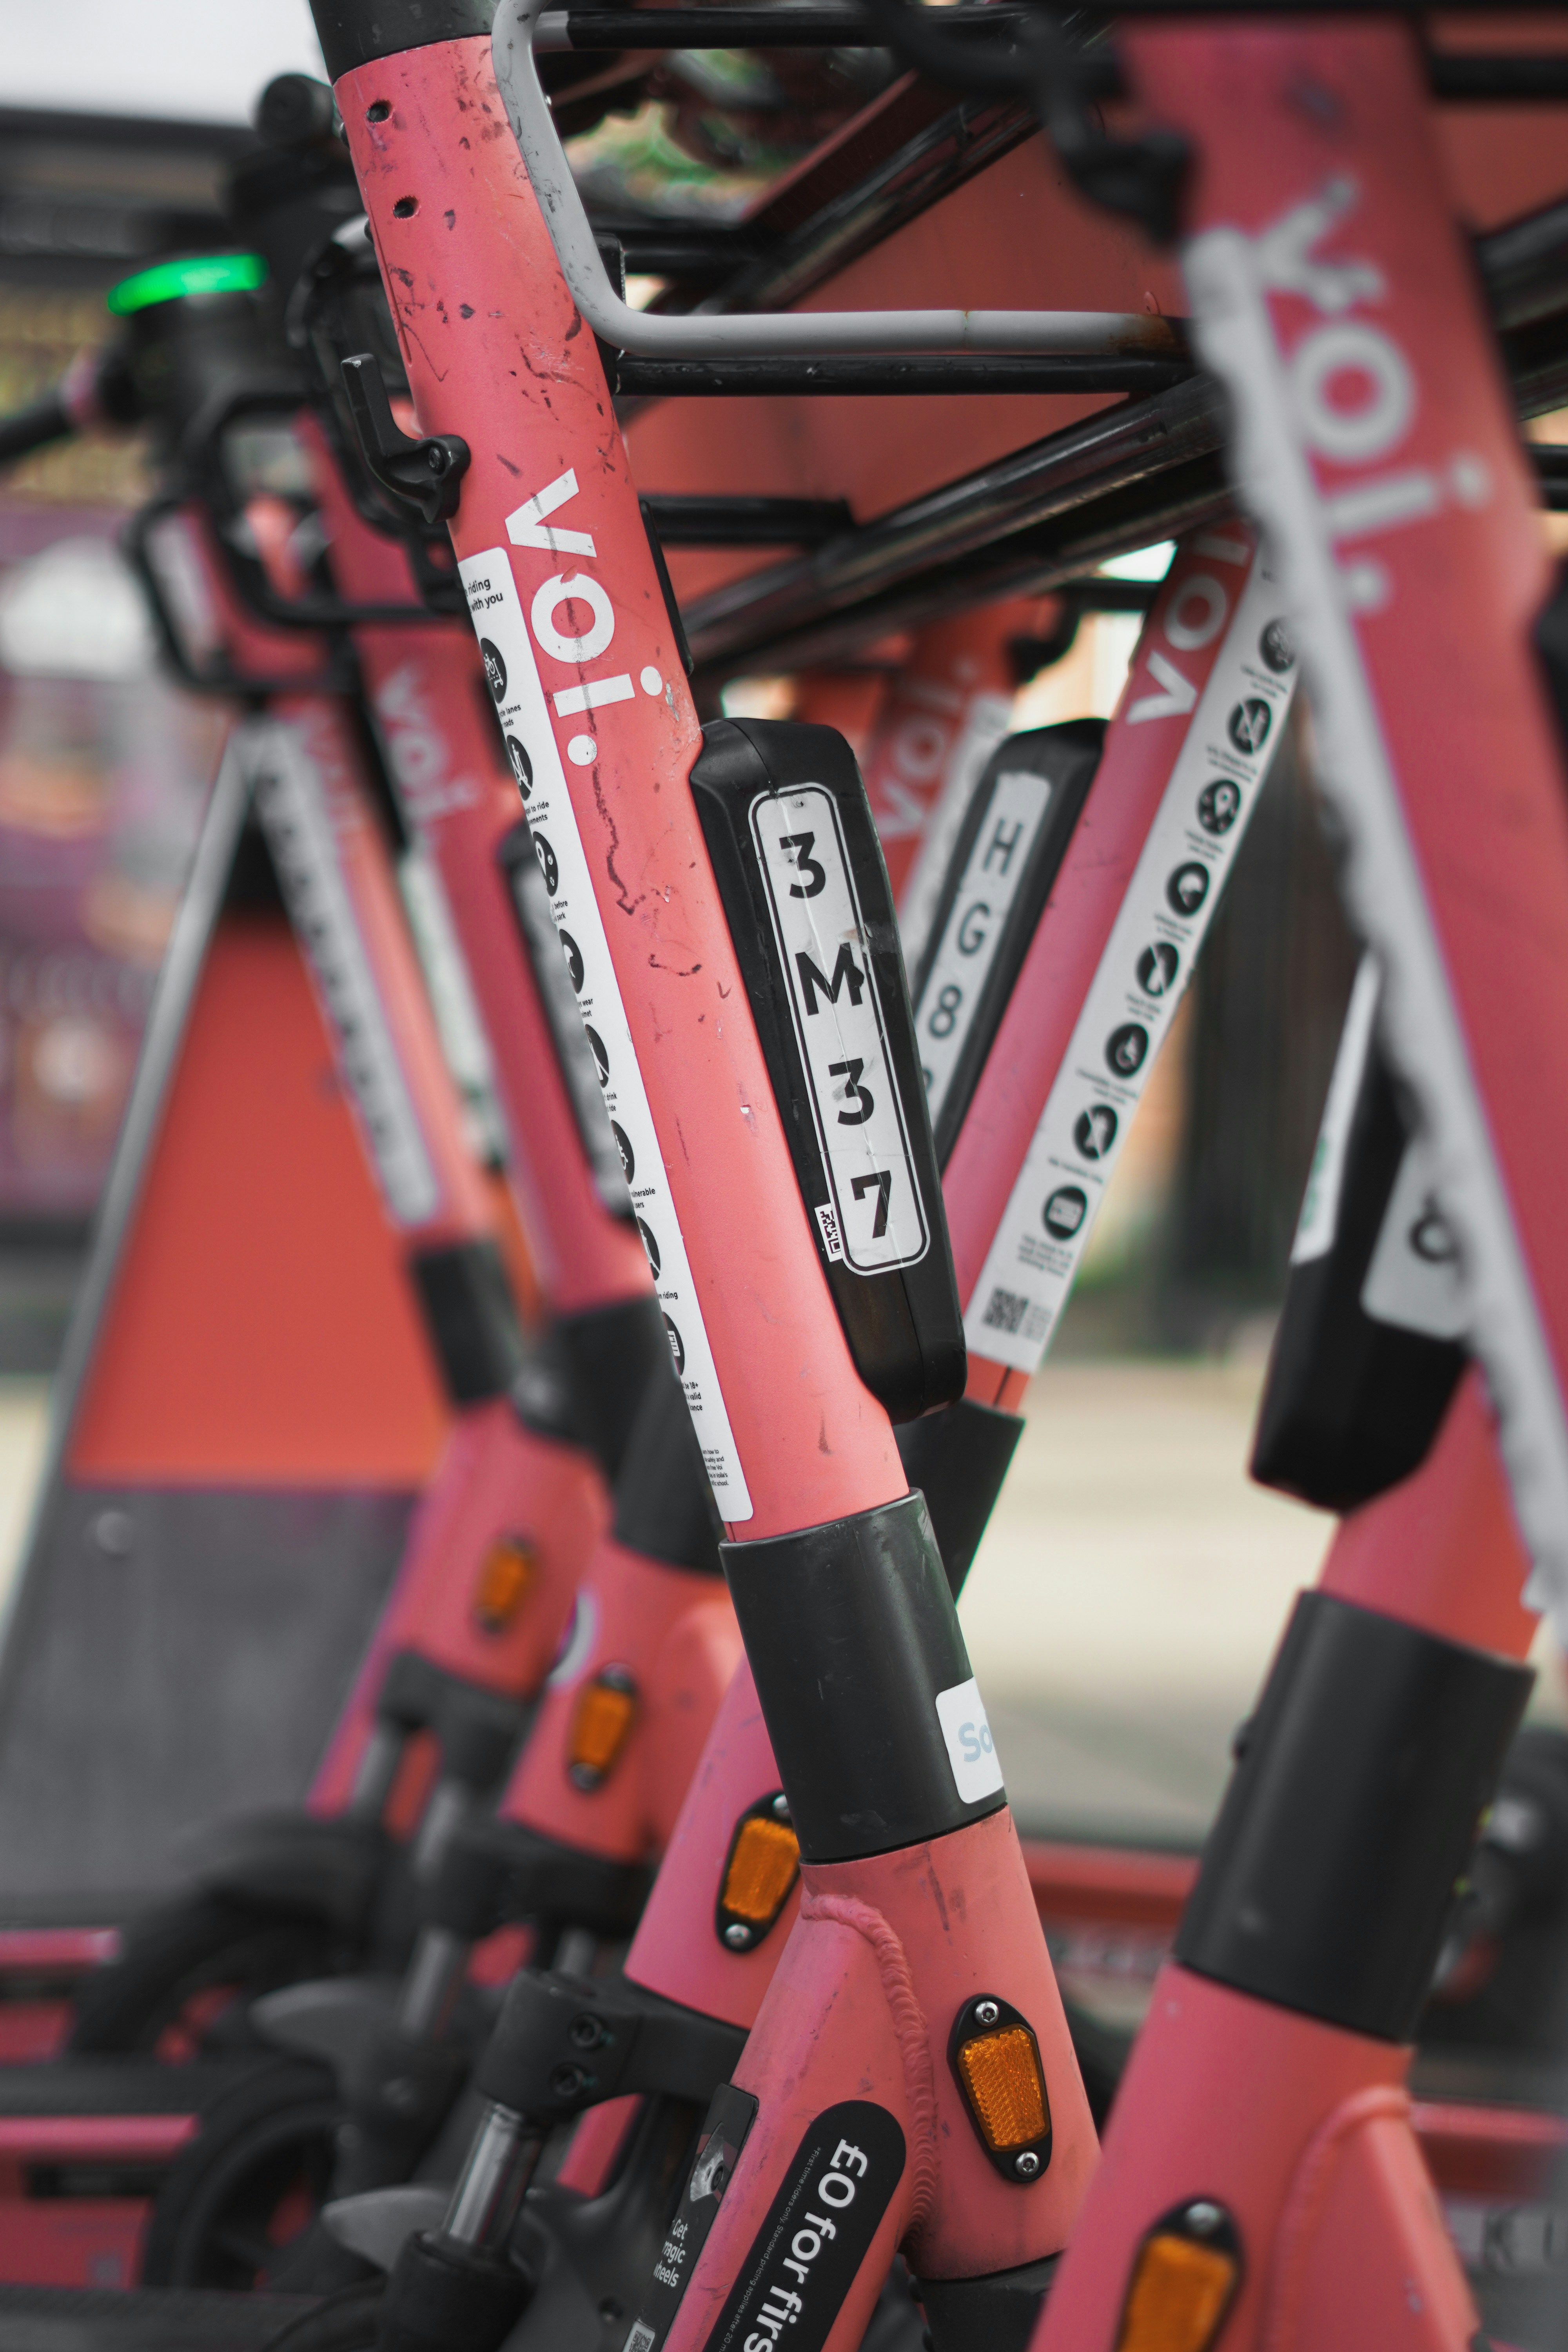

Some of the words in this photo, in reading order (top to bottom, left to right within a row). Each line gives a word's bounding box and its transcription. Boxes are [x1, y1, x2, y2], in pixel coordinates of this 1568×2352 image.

[468, 579, 491, 595] riding
[471, 598, 484, 612] with
[484, 593, 503, 609] you
[506, 705, 521, 715] lanes
[537, 801, 549, 811] ride
[554, 900, 568, 910] before
[557, 911, 566, 923] park
[606, 1092, 617, 1101] drink
[662, 1291, 678, 1300] riding
[690, 1392, 701, 1400] valid
[799, 2166, 811, 2184] time
[788, 2184, 802, 2206] riders
[672, 2218, 688, 2240] Get
[763, 2225, 784, 2259] Standard
[783, 2212, 836, 2284] for
[749, 2258, 766, 2286] pricing
[738, 2286, 753, 2313] applies
[730, 2314, 740, 2332] after
[724, 2332, 733, 2343] 20
